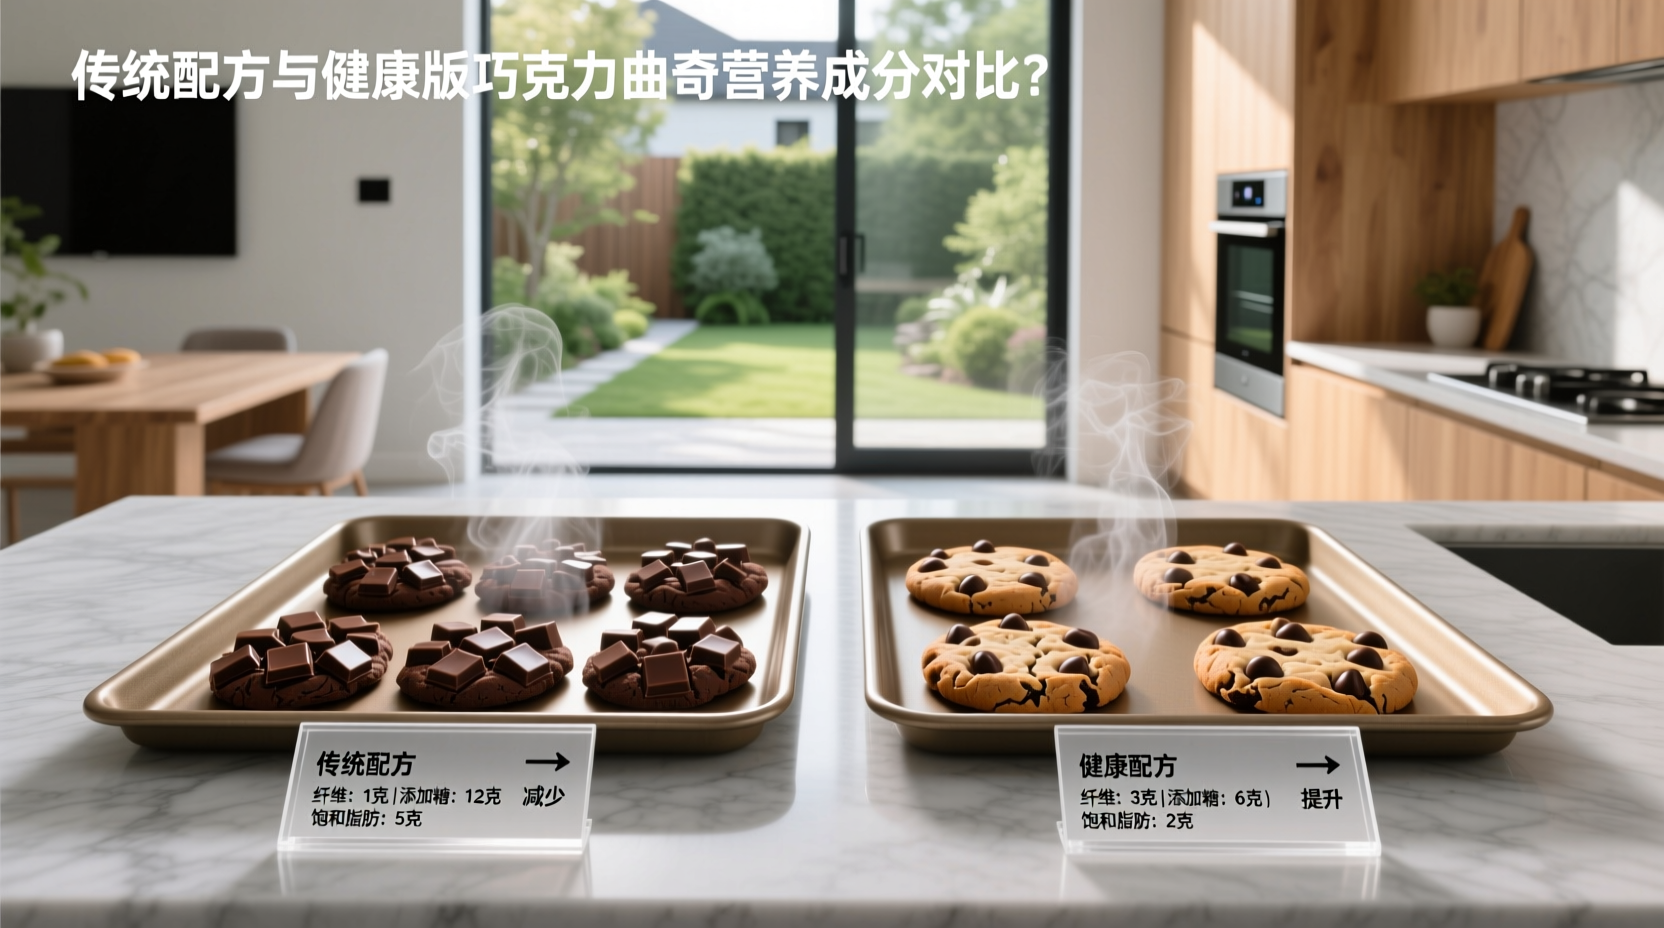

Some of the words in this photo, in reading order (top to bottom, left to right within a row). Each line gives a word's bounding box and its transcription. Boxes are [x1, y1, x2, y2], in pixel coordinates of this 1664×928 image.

[316, 750, 417, 777] 传统配方
[1079, 752, 1178, 779] 健康配方
[522, 785, 566, 808] 减少
[1300, 787, 1343, 810] 提升
